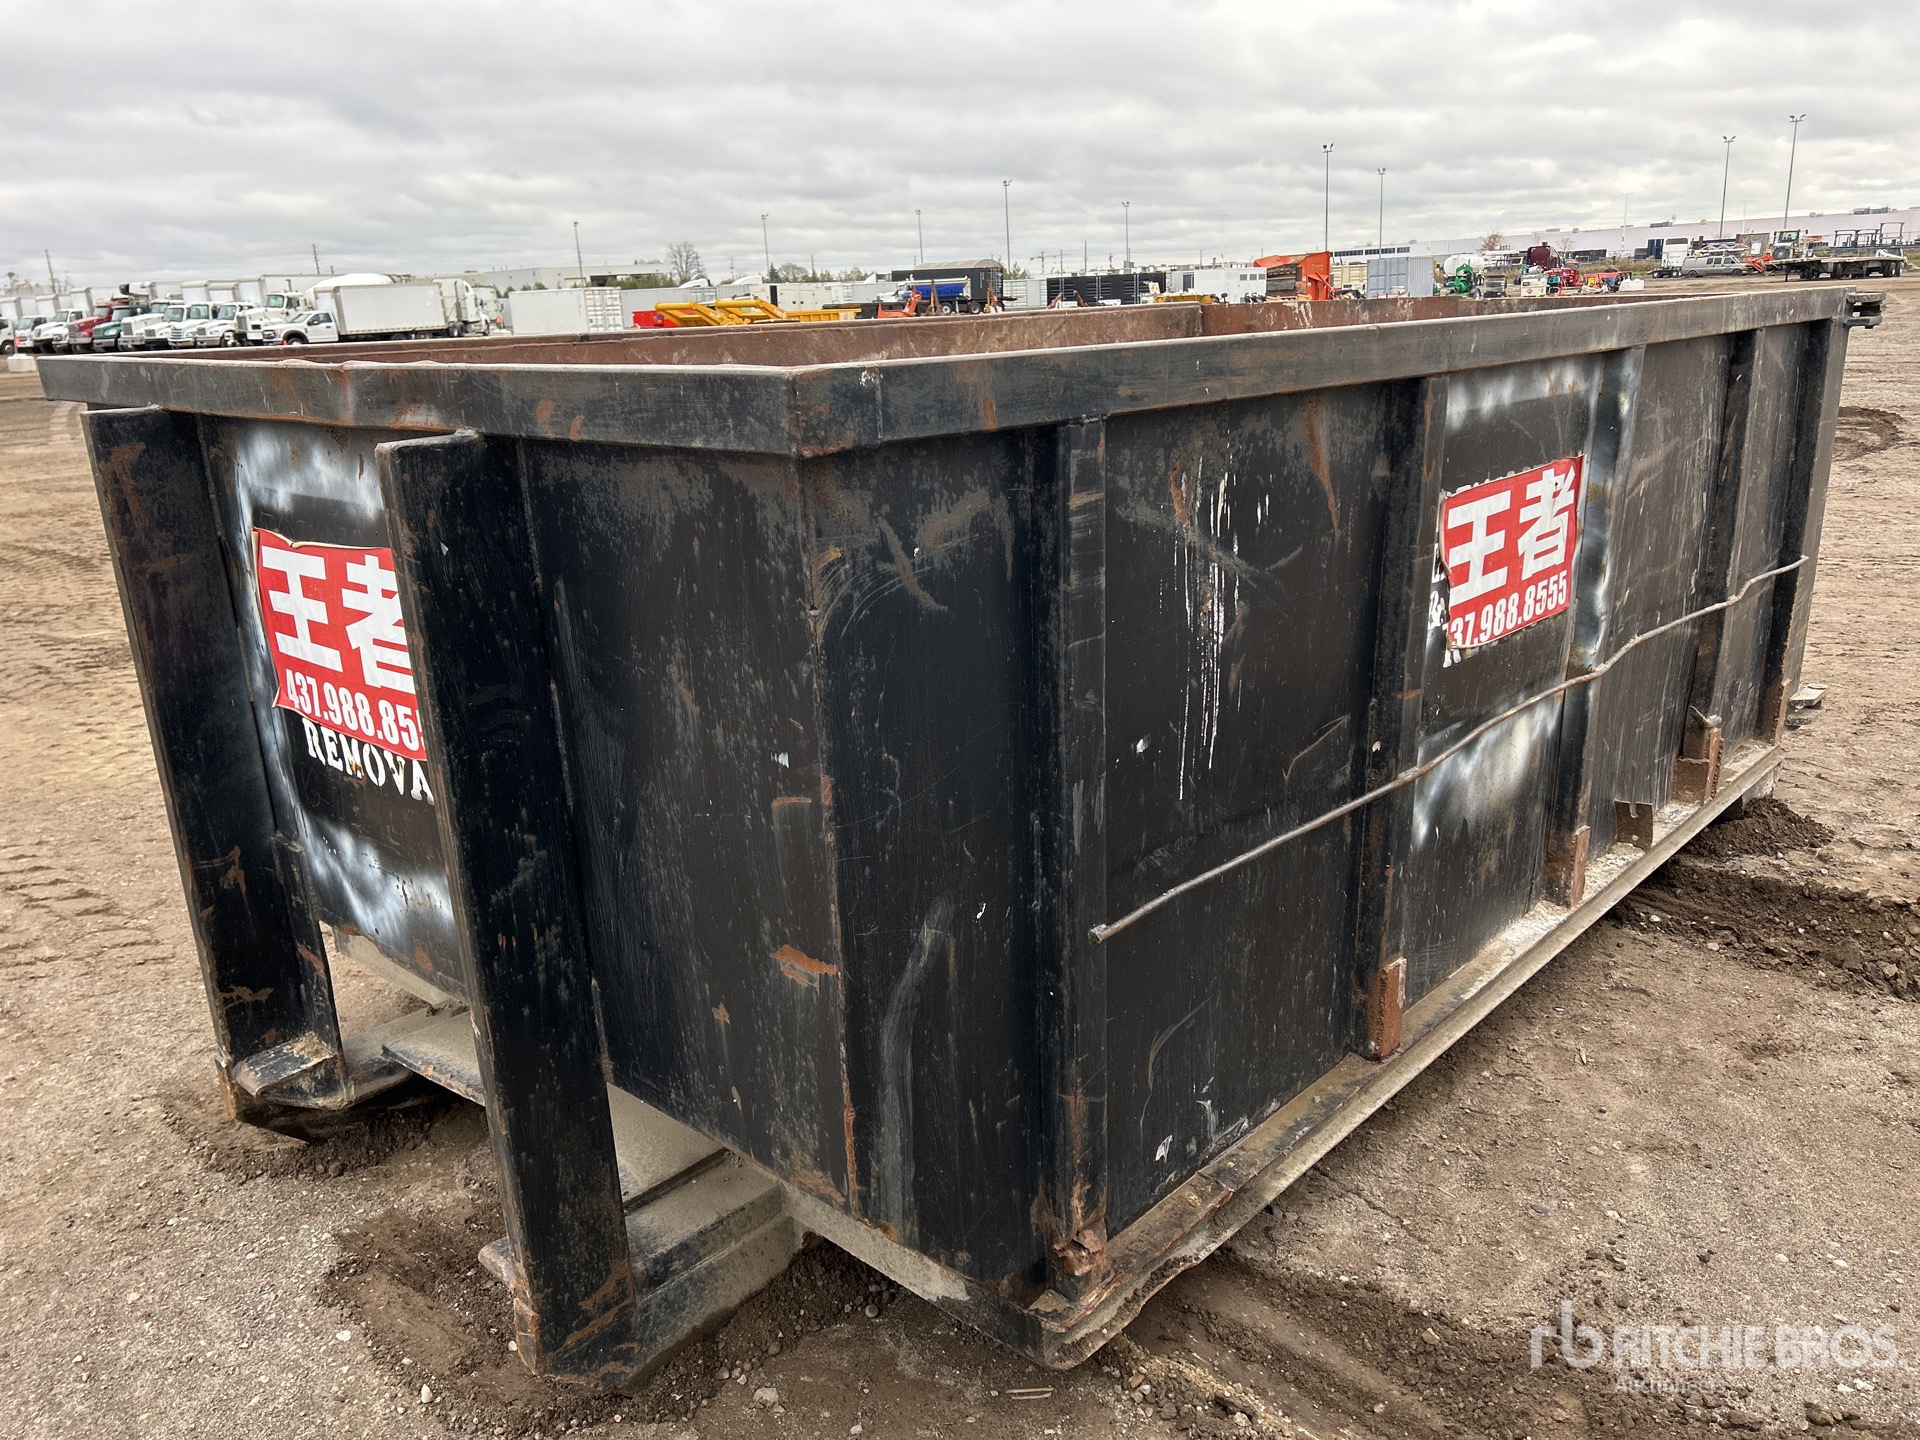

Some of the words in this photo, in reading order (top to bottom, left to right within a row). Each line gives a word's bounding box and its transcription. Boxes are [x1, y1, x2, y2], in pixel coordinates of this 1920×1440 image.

[1447, 466, 1576, 606] 王者
[261, 545, 416, 694] 王者
[1443, 570, 1568, 646] 37.988.8555
